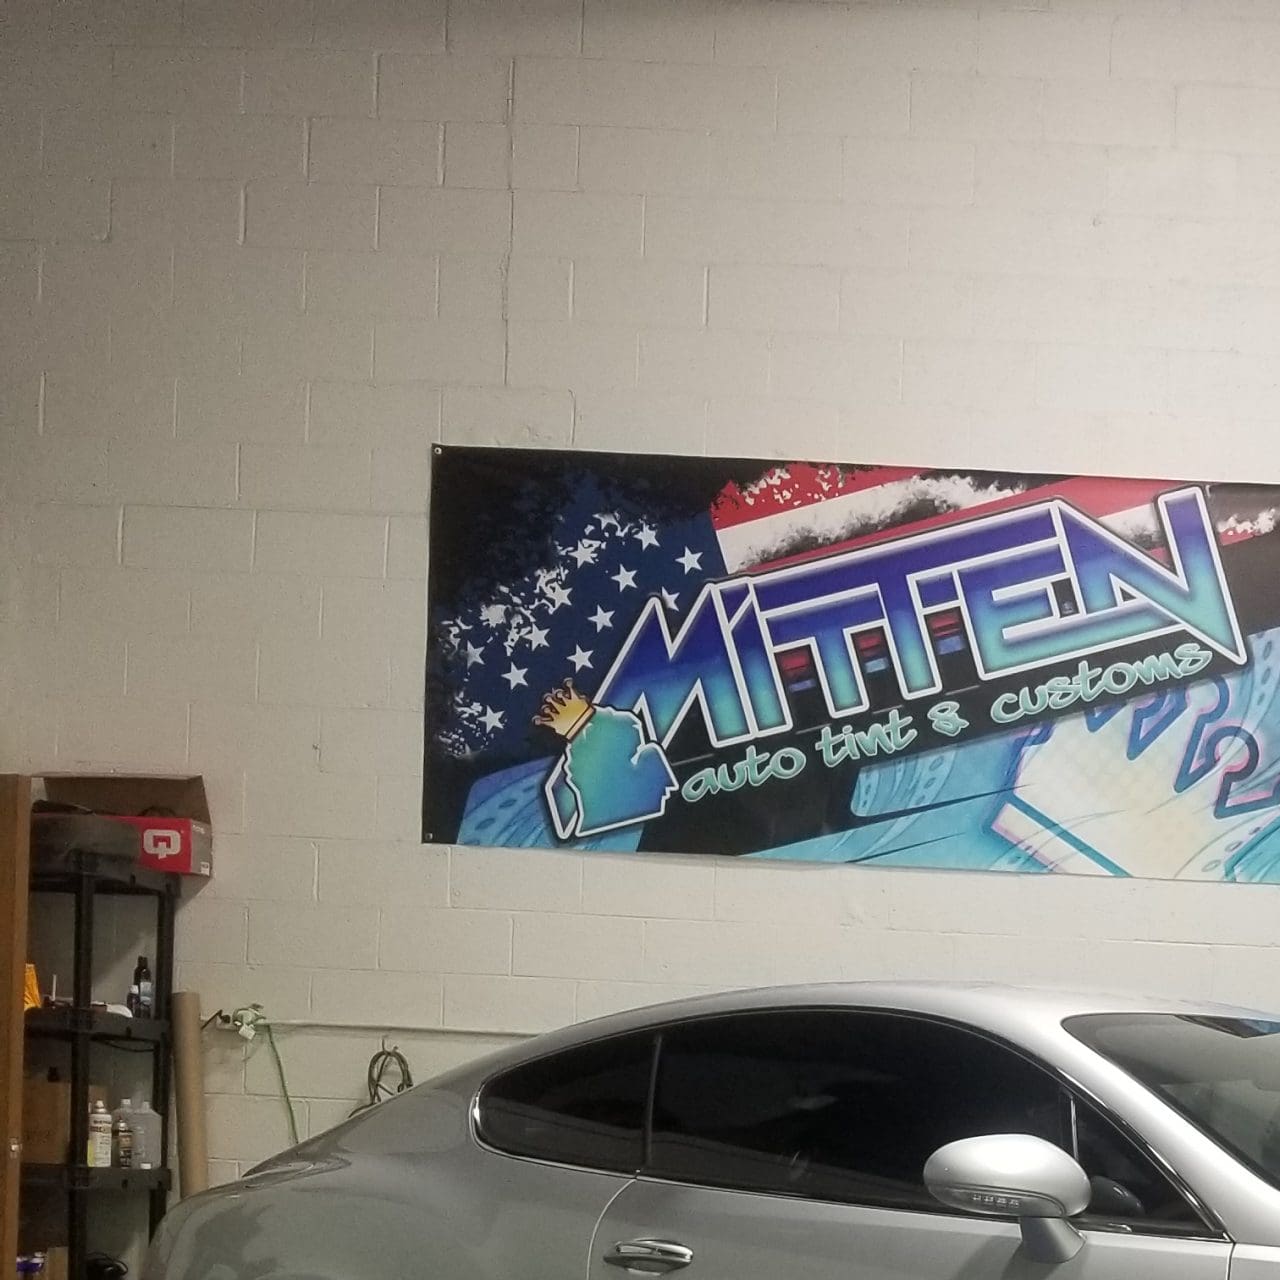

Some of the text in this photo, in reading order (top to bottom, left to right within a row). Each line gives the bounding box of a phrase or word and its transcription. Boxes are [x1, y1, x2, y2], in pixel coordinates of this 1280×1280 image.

[681, 643, 1212, 802] auto tint & customs
